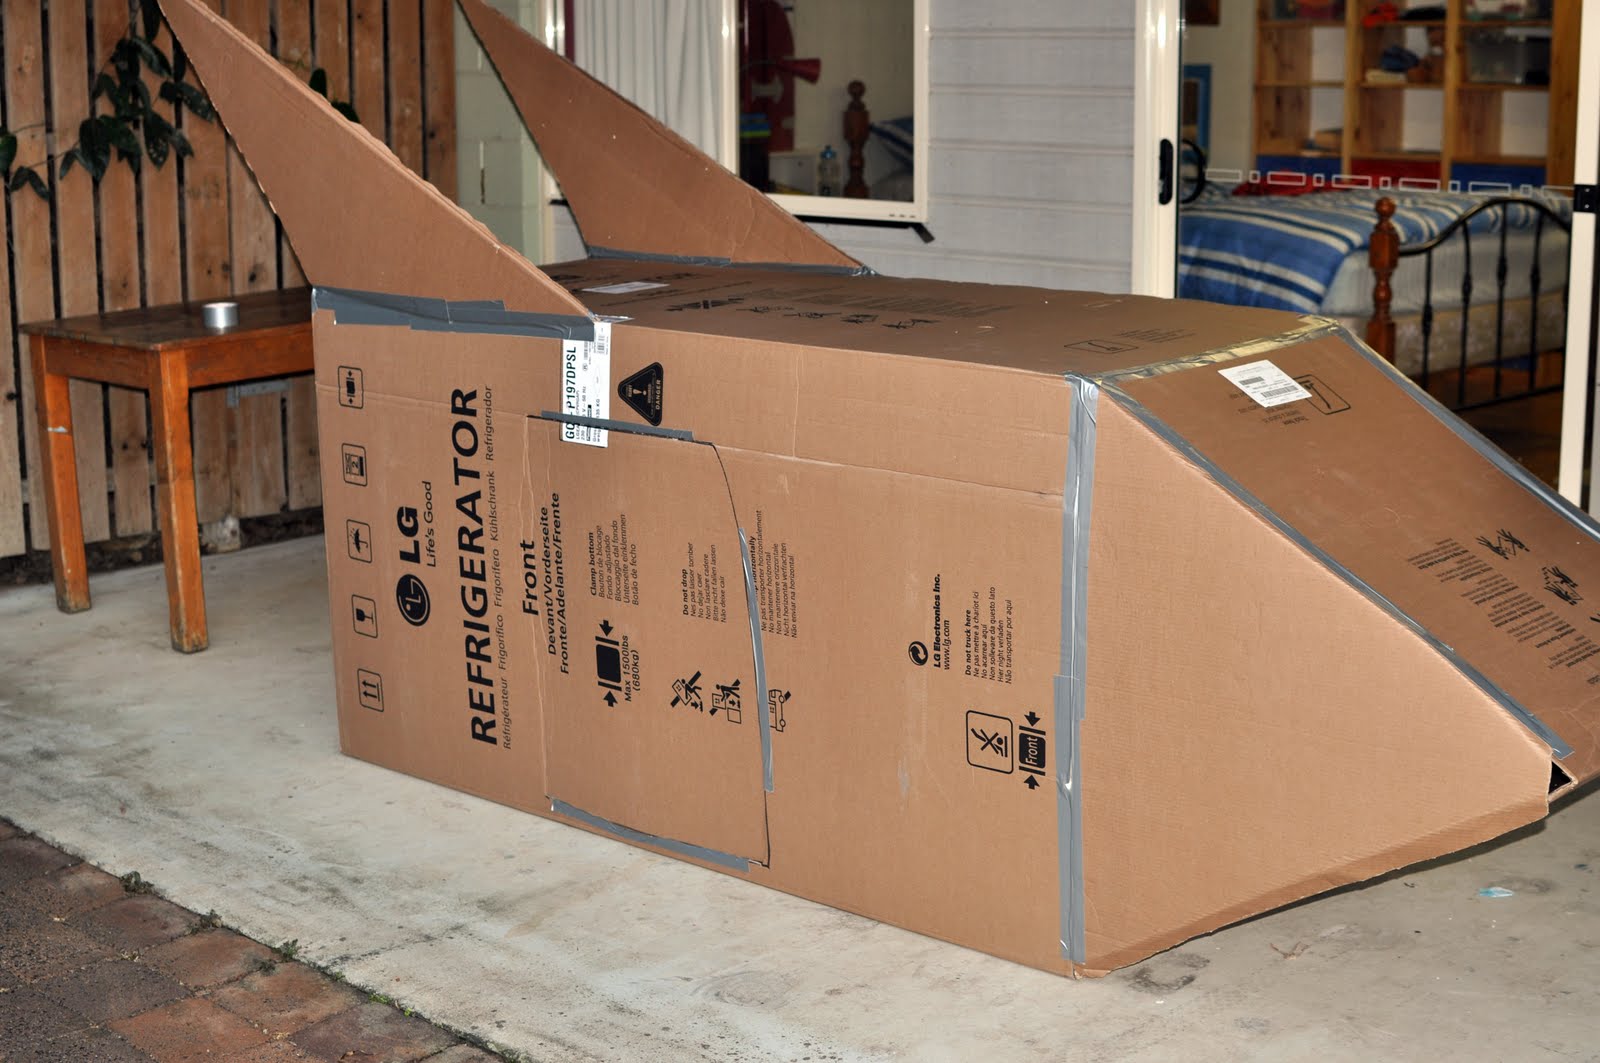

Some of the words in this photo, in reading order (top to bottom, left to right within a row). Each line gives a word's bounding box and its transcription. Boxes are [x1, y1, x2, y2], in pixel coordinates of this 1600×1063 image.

[483, 386, 494, 460] Refrigerador
[422, 481, 433, 523] Good
[487, 471, 498, 540] Kühlschrank
[396, 505, 421, 564] LG
[425, 528, 436, 567] Life's
[620, 514, 628, 562] einklemmen
[451, 388, 497, 745] REFRIGERATOR
[520, 539, 539, 616] Front
[540, 506, 556, 656] Devant/Vorderseite
[596, 558, 603, 567] de
[613, 560, 622, 601] Bloccaggio
[630, 569, 637, 578] de
[552, 492, 569, 675] Fronte/Adelante/Frente
[605, 575, 613, 599] Fondo
[622, 564, 630, 603] Unterseite
[791, 591, 795, 600] na
[683, 604, 688, 615] Do
[698, 608, 703, 618] No
[761, 622, 767, 631] Ne
[768, 623, 774, 632] No
[942, 620, 951, 669] www.lg.com
[989, 626, 995, 634] da
[622, 635, 630, 674] 1500lbs
[630, 650, 640, 690] (680kg)
[934, 654, 940, 667] LG
[965, 665, 971, 675] Do
[973, 668, 979, 677] Ne
[981, 669, 987, 678] No
[501, 677, 511, 749] Réfrigérateur
[1025, 735, 1038, 766] Front
